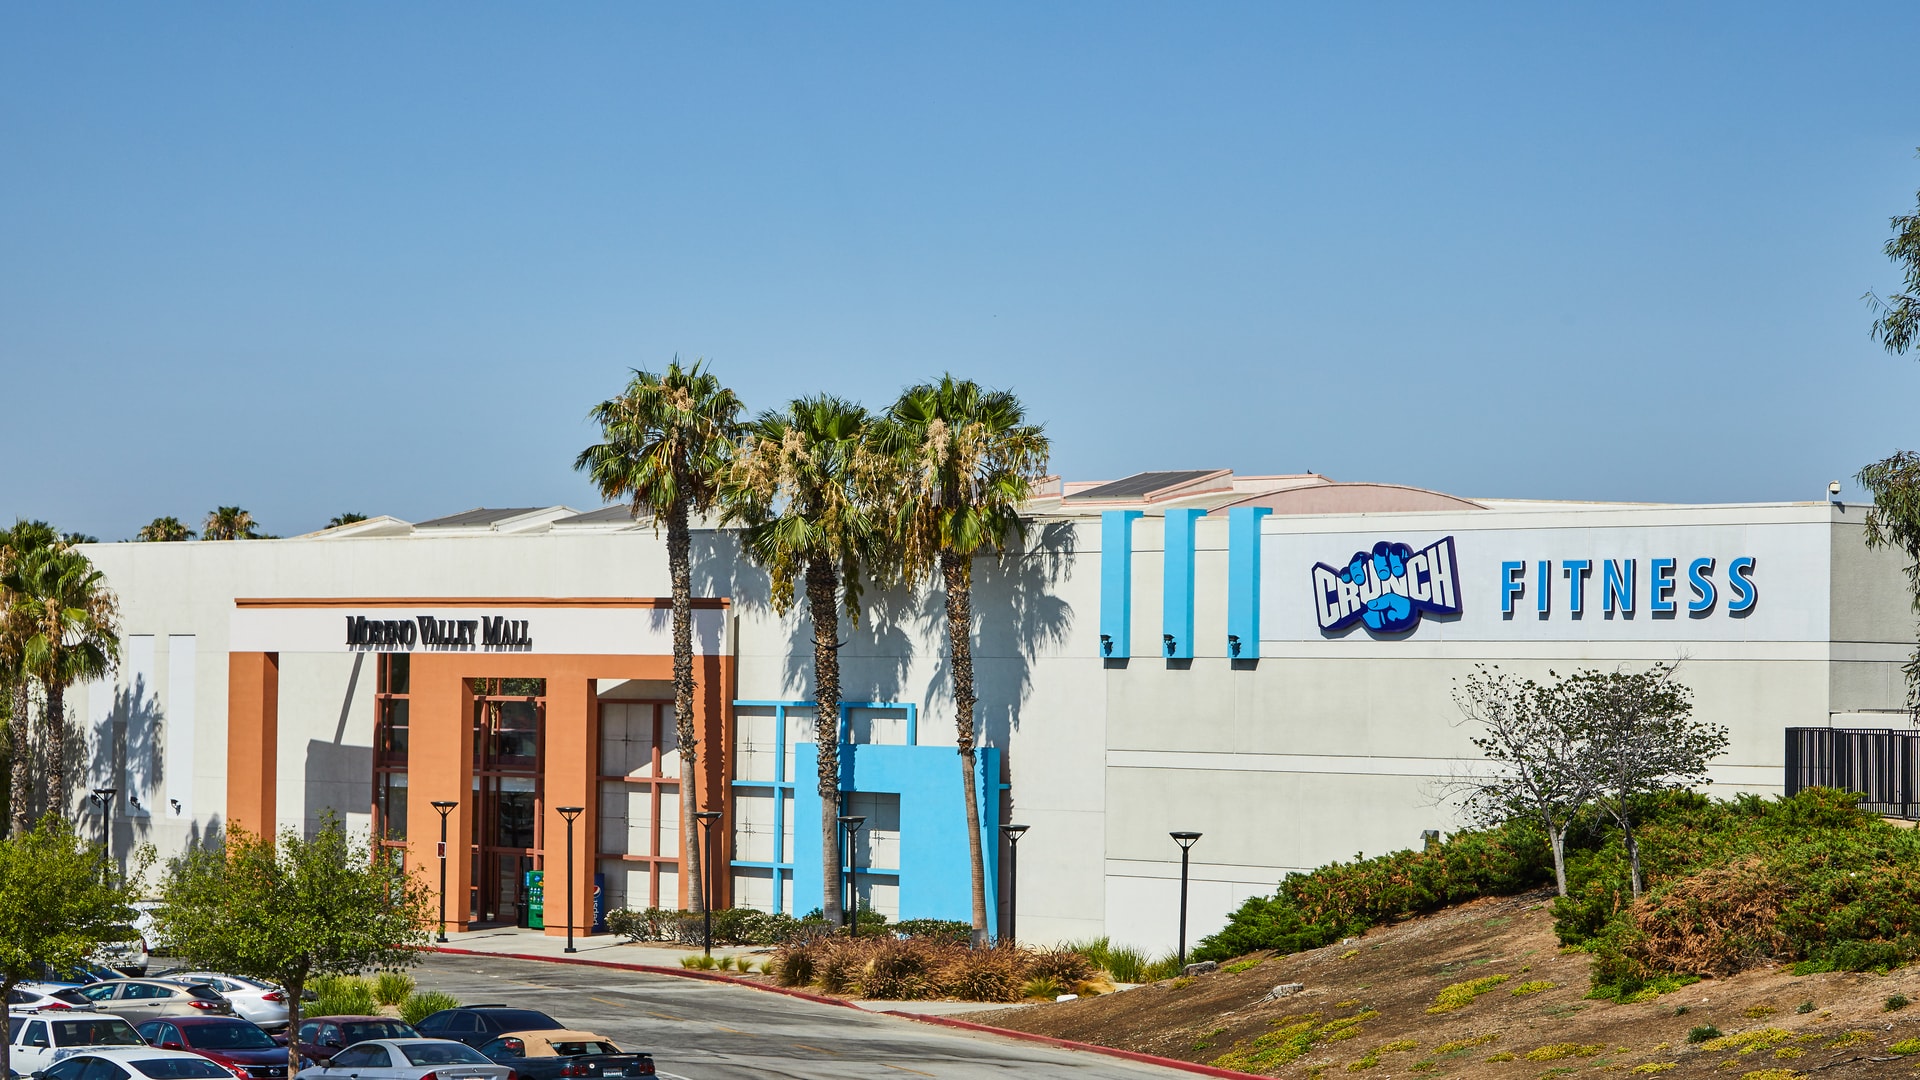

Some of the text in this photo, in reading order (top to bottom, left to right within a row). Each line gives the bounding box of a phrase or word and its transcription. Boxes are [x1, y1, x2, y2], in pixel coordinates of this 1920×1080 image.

[1314, 541, 1758, 628] CRUNCH FITNESS
[346, 616, 532, 646] MORENO VALLEY MALL
